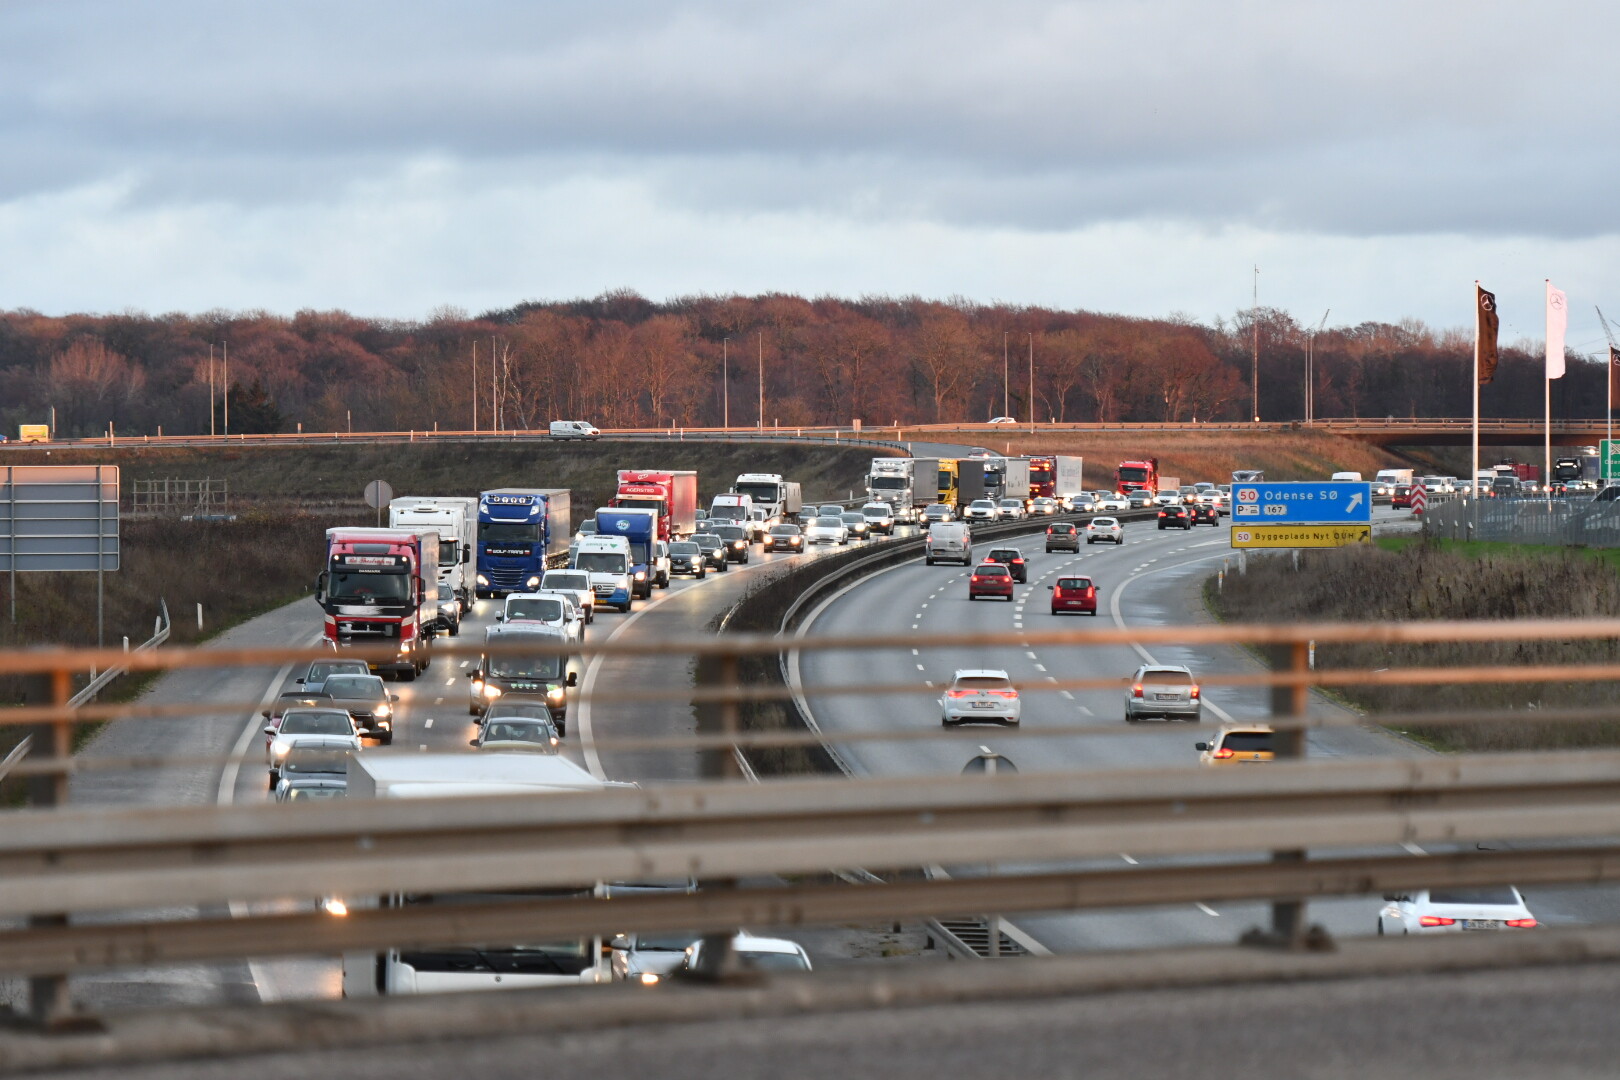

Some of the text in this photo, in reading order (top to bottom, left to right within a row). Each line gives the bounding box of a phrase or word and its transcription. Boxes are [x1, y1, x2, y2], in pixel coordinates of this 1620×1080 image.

[1240, 491, 1338, 500] 50 Odense SØ
[1238, 533, 1249, 541] 50
[1255, 533, 1310, 541] Byggeplads
[1313, 533, 1329, 541] Nyt
